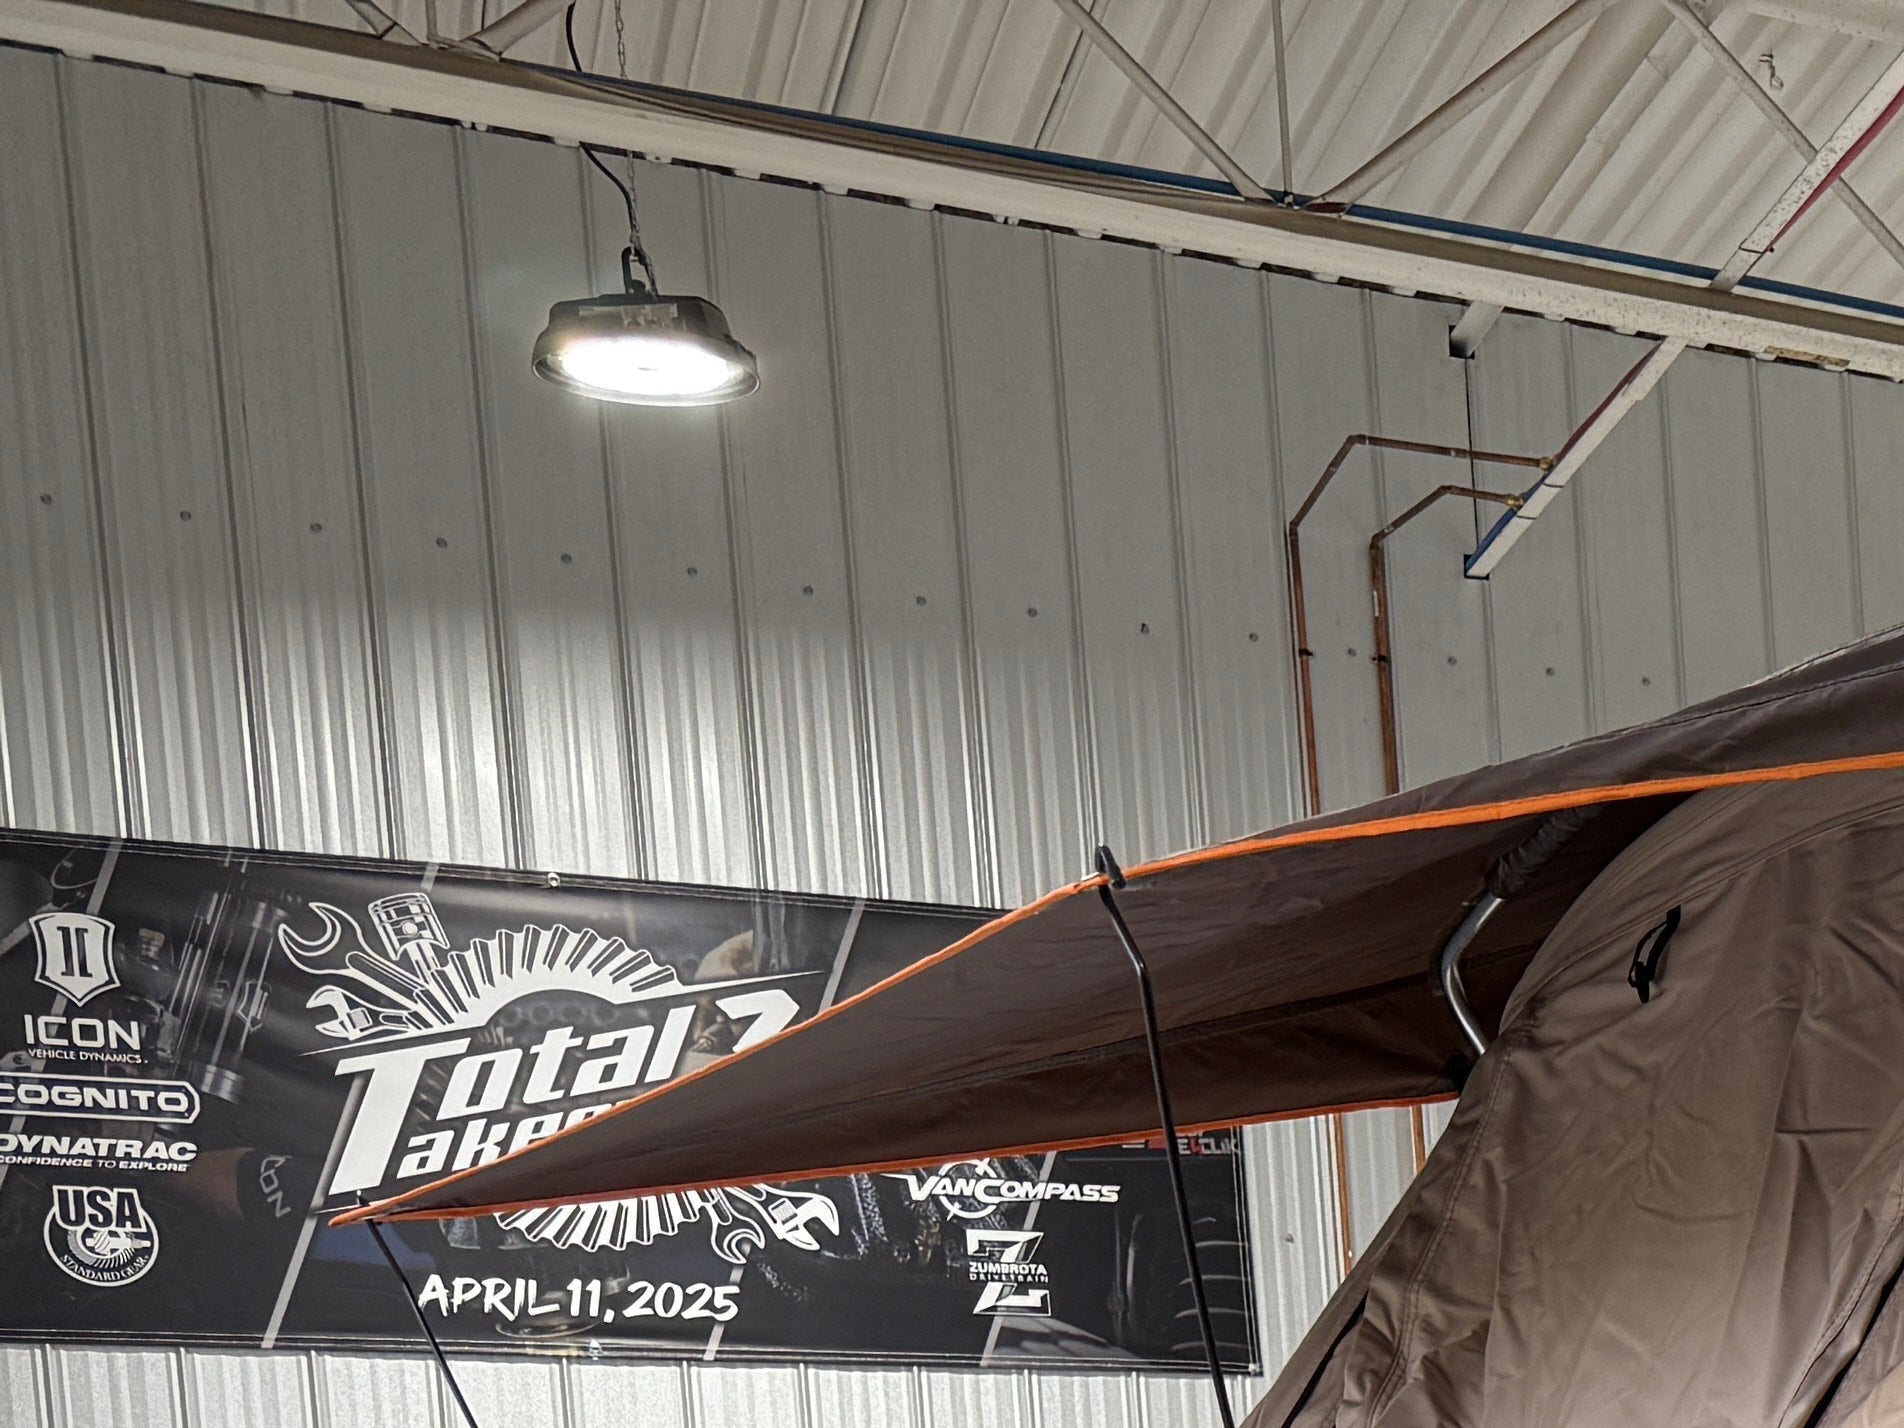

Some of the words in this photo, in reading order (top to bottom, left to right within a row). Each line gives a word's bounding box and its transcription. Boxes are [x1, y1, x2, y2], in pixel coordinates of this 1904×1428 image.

[24, 1014, 140, 1050] ICON
[28, 1049, 76, 1060] VEHICLE
[80, 1051, 142, 1063] DYNAMICS
[328, 1004, 697, 1196] Total
[0, 1133, 198, 1161] DYNATRAC
[98, 1160, 116, 1169] TO
[119, 1161, 189, 1172] EXPLORE
[54, 1187, 145, 1230] USA
[60, 1254, 121, 1281] STANDARD
[121, 1256, 148, 1280] GEAR
[969, 1262, 1047, 1275] ZUMBROTA
[418, 1274, 559, 1322] APRIL
[567, 1278, 614, 1324] 11,
[626, 1282, 740, 1321] 2025
